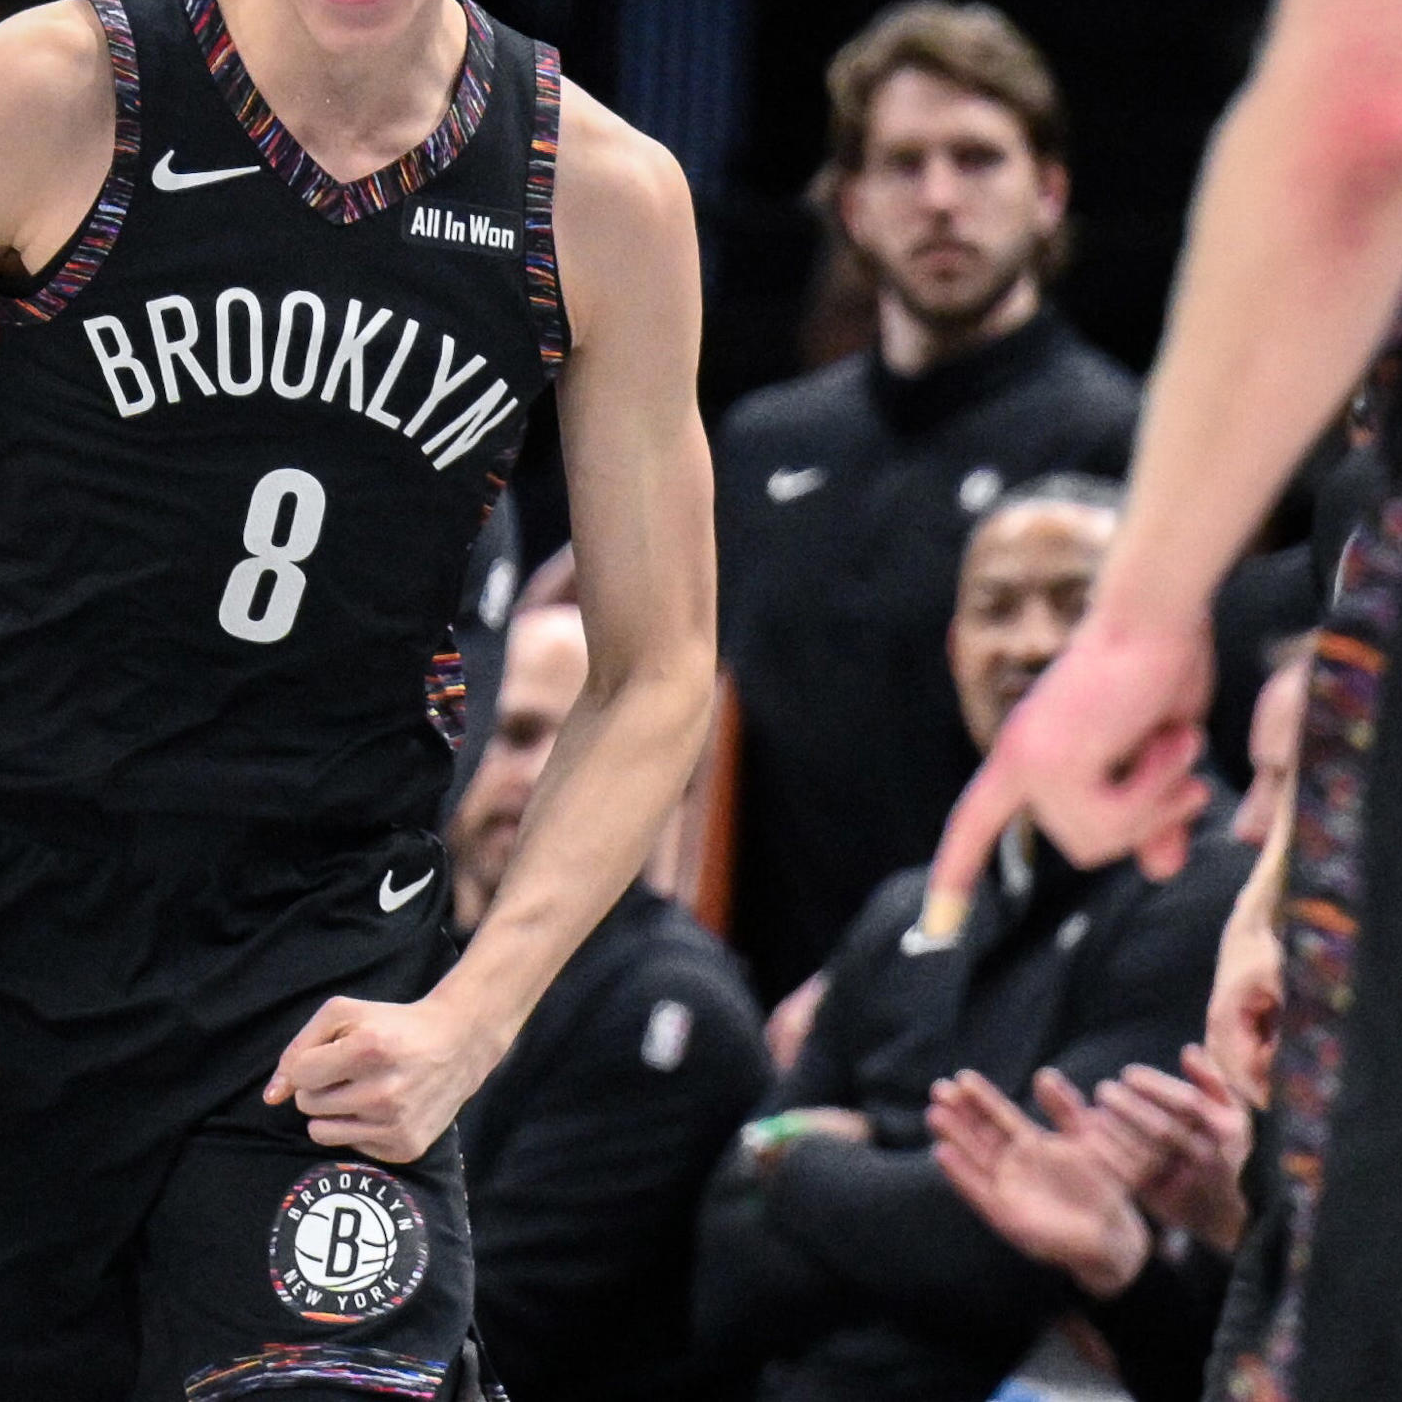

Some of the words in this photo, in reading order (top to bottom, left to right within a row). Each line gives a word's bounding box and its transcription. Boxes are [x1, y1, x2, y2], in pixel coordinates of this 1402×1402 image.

[410, 206, 440, 238] All
[444, 210, 465, 242] In
[469, 214, 514, 250] Won
[83, 286, 519, 472] BROOKLYN
[218, 467, 326, 643] 8
[287, 1173, 414, 1231] BROOKLYN
[325, 1206, 362, 1278] B
[283, 1268, 323, 1306] NEW
[337, 1275, 400, 1311] YORK
